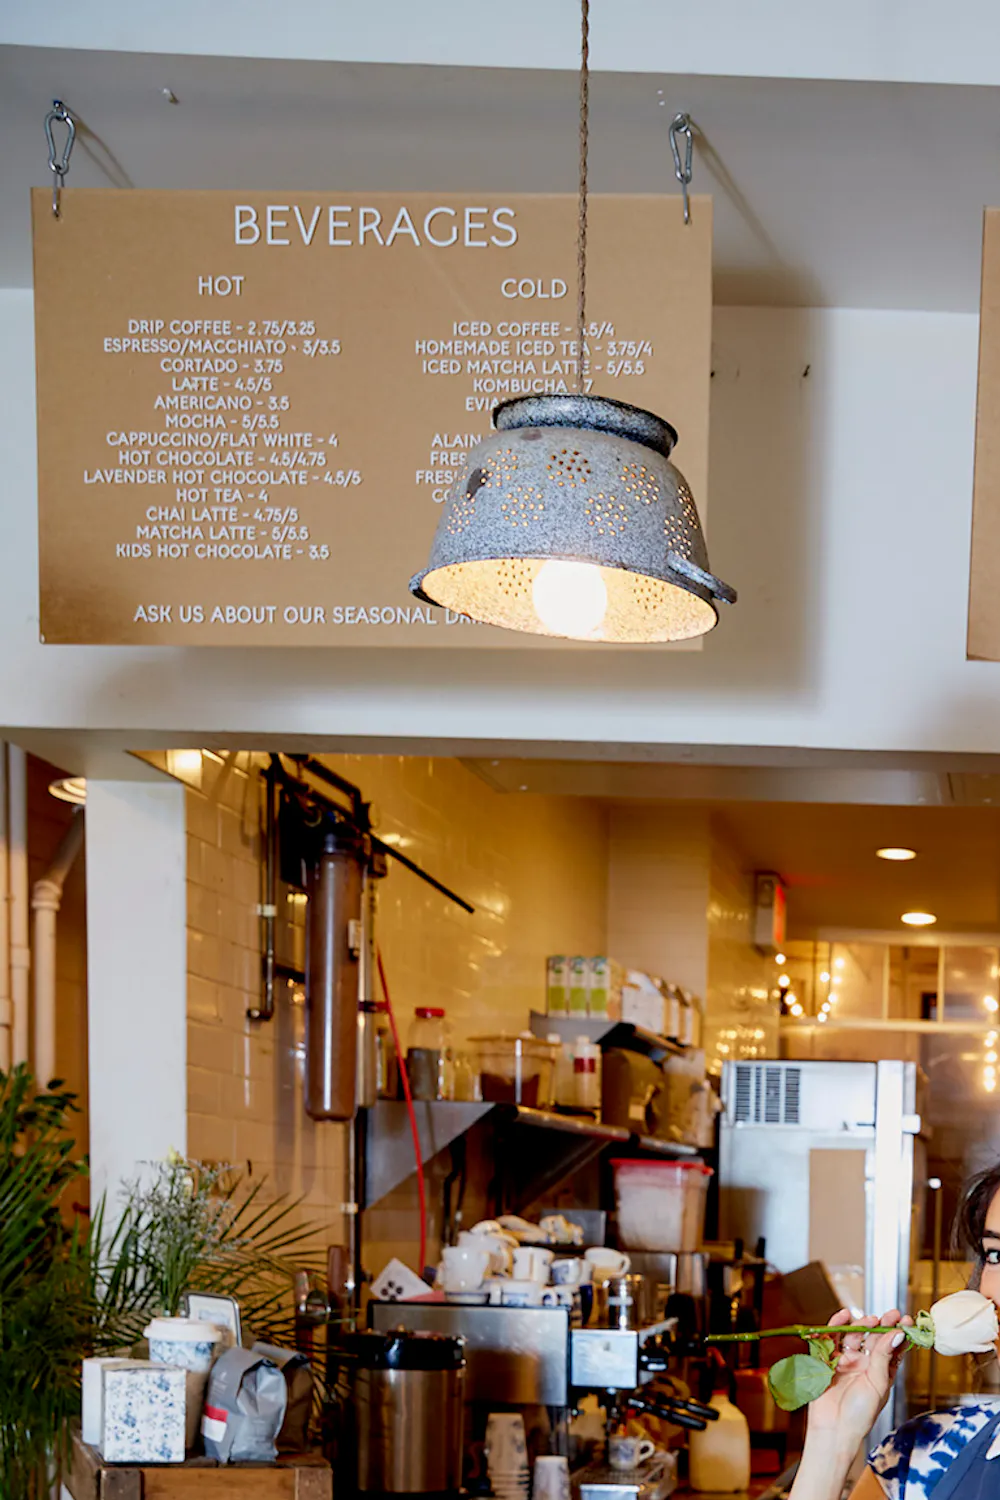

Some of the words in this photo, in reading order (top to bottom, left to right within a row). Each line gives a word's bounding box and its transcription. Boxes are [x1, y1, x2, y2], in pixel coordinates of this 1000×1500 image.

[234, 204, 517, 248] BEVERAGES
[197, 274, 245, 297] HOT
[500, 277, 567, 299] COLD
[127, 318, 165, 335] DRIP
[168, 319, 232, 336] COFFEE
[452, 320, 492, 337] ICED
[496, 320, 561, 337] COFFEE
[578, 320, 615, 339] .5/4
[103, 336, 287, 355] ESPRESSO/MACCHIATO
[414, 339, 510, 356] HOMEMADE
[516, 339, 555, 356] ICED
[159, 357, 238, 374] CORTADO
[422, 358, 462, 375] ICED
[466, 359, 537, 375] MATCHA
[171, 376, 219, 392] LATTE
[472, 377, 568, 393] KOMBUCHA
[153, 394, 252, 411] AMERICANO
[465, 396, 503, 412] EVIA
[165, 413, 226, 429] MOCHA
[105, 430, 259, 447] CAPPUCCINO/FLAT
[262, 431, 313, 448] WHITE
[118, 449, 152, 466] HOT
[156, 449, 254, 467] CHOCOLATE
[83, 468, 167, 485] LAVENDER
[172, 469, 205, 485] HOT
[209, 469, 309, 486] CHOCOLATE
[175, 487, 209, 503] HOT
[213, 487, 244, 503] TEA
[145, 505, 185, 522] CHAI
[191, 505, 238, 523] LATTE
[135, 524, 204, 540] MATCHA
[209, 525, 256, 541] LATTE
[115, 542, 152, 559] KIDS
[156, 542, 190, 559] HOT
[193, 543, 292, 560] CHOCOLATE
[132, 603, 172, 623] ASK
[178, 604, 204, 624] US
[209, 604, 277, 625] ABOUT
[283, 605, 326, 625] OUR
[332, 605, 438, 625] SEASONAL
